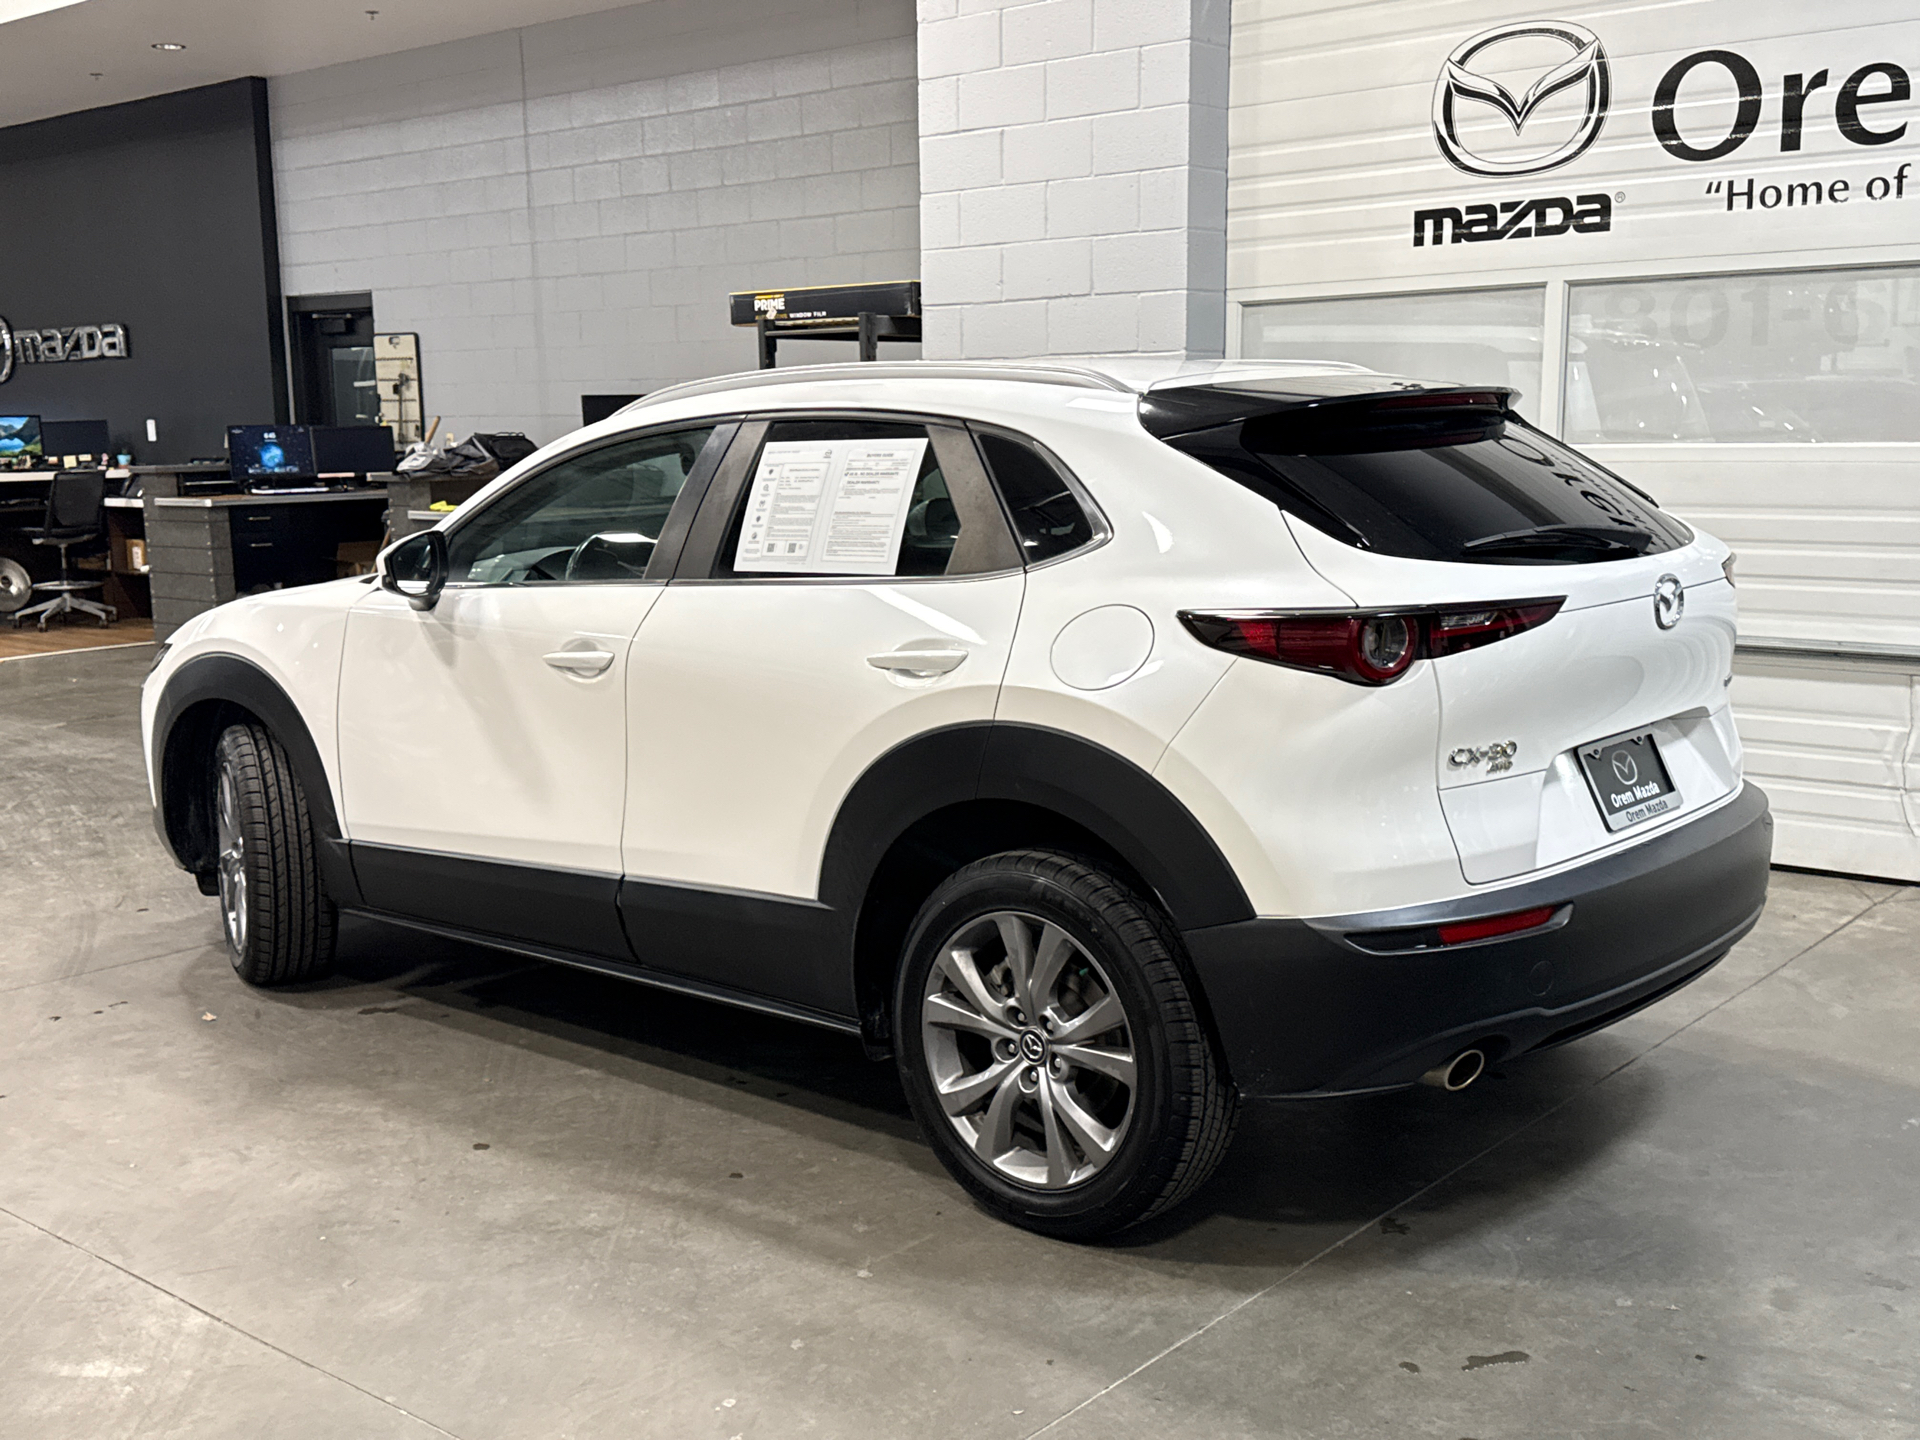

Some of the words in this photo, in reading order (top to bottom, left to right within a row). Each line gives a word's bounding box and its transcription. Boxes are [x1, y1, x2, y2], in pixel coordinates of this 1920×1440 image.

[1652, 49, 1911, 162] Ore
[1866, 163, 1911, 201] of
[754, 298, 785, 311] PRIME
[1611, 791, 1635, 808] Orem
[1632, 781, 1660, 800] Mazda
[1626, 810, 1646, 822] Orem
[1645, 799, 1668, 815] Mazda
